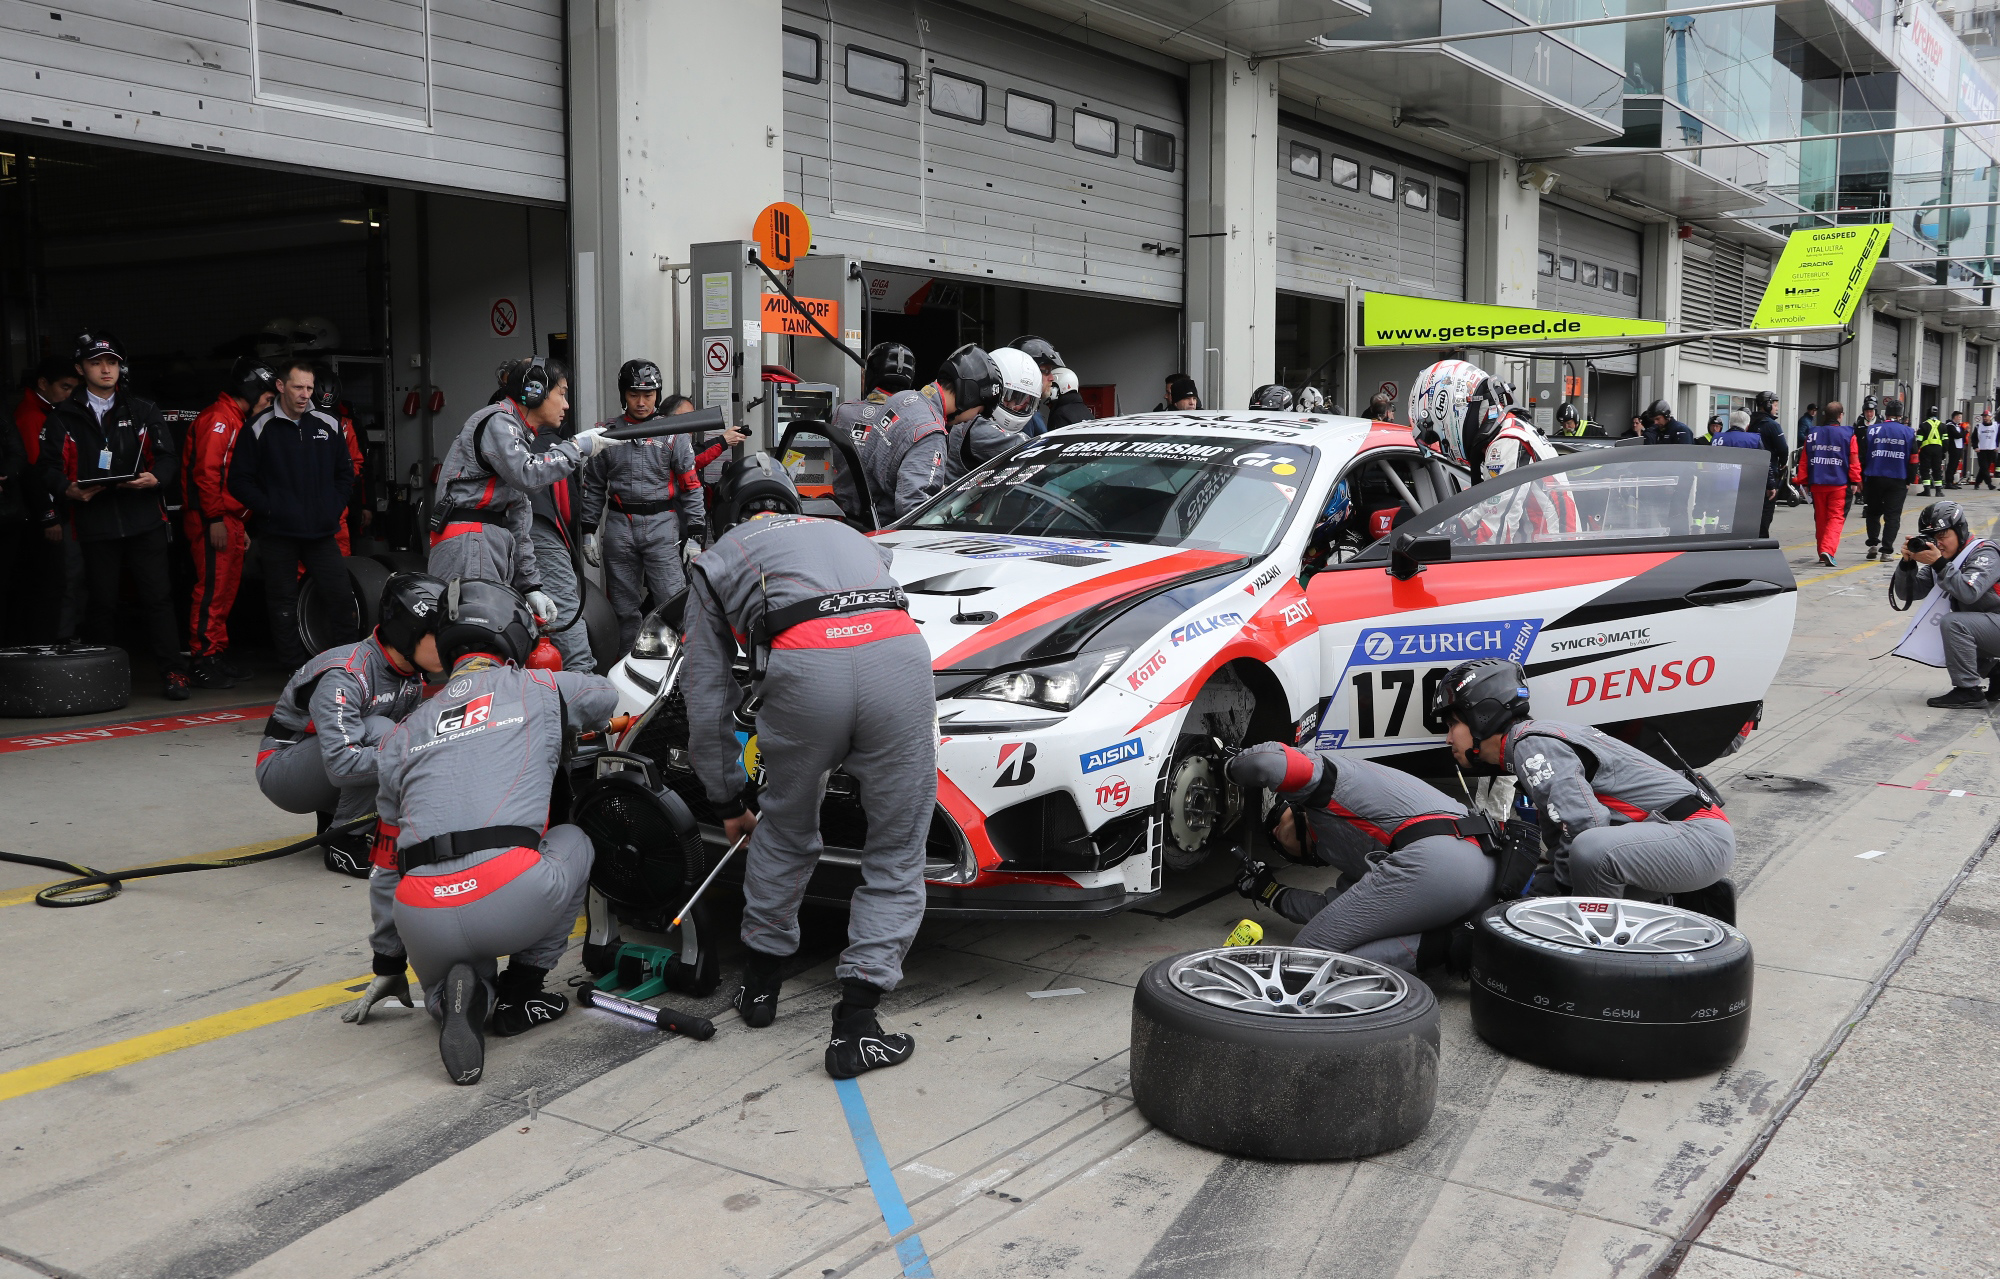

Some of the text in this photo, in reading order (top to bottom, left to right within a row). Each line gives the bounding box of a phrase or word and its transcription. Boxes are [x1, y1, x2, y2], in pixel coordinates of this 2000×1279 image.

[919, 18, 931, 32] 12
[1534, 41, 1550, 86] 11
[1812, 231, 1857, 241] GIGASPEED
[1824, 244, 1844, 253] ULTRA
[871, 278, 889, 289] GIGA
[764, 297, 830, 318] MUNDORF
[781, 317, 813, 334] TANK
[1770, 315, 1806, 324] kwmobile
[1376, 318, 1582, 342] www.getspeed.de
[1435, 392, 1447, 415] Arai
[1186, 421, 1302, 438] Racing
[1805, 432, 1817, 443] 31
[1868, 425, 1882, 437] 47
[1063, 441, 1121, 453] GRAN
[1873, 437, 1905, 446] DMSB
[1104, 452, 1146, 460] DRIVING
[1147, 453, 1209, 462] SIMULATOR
[1252, 564, 1282, 590] YAZAKI
[1279, 597, 1313, 627] ZENT
[826, 622, 873, 639] sparco
[1169, 612, 1246, 647] FALKEN
[1399, 630, 1502, 655] ZURICH
[1507, 621, 1535, 664] RHEIN
[1566, 655, 1716, 707] DENSO
[176, 711, 246, 726] PIT
[437, 704, 491, 735] GR
[9, 725, 148, 748] LANE
[409, 715, 524, 754] TOYOTA GAZOO Racing
[1087, 742, 1138, 770] AISIN
[433, 878, 478, 897] sparco
[1578, 902, 1609, 914] BBS
[1602, 1006, 1640, 1019] MA99
